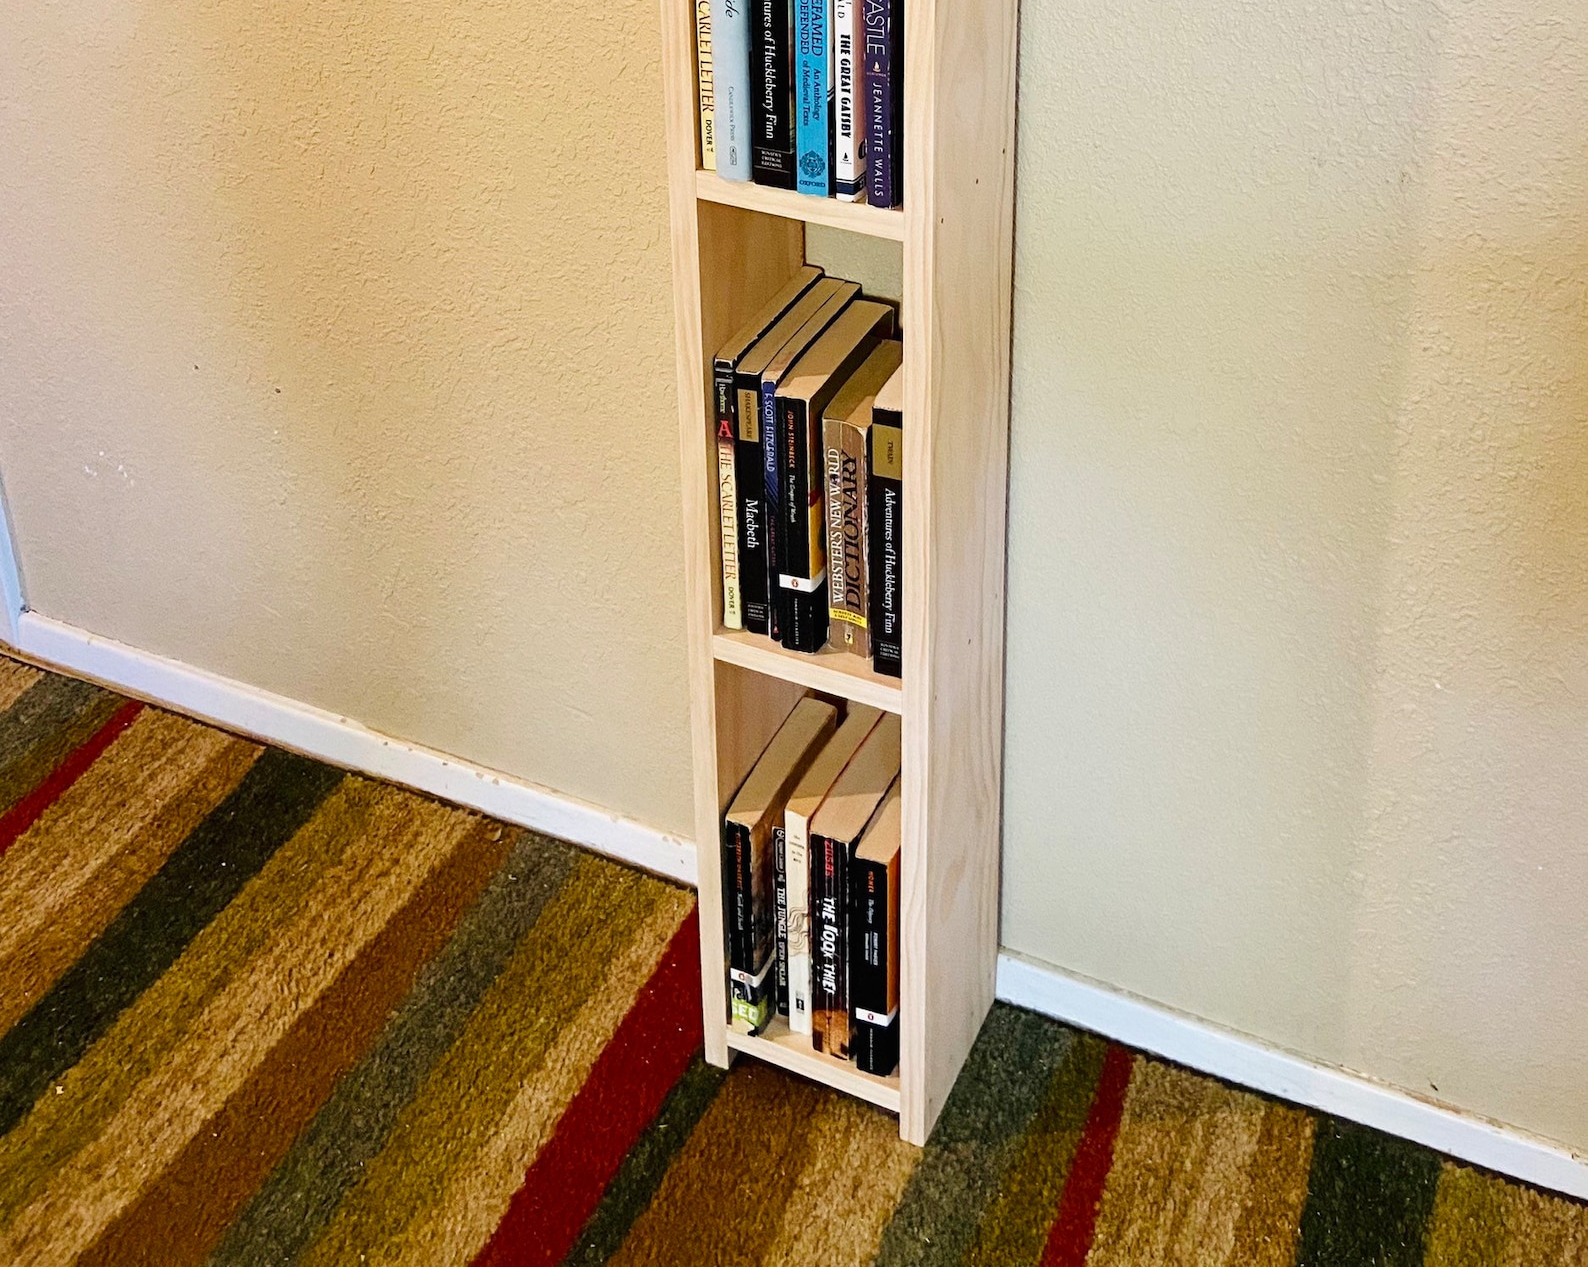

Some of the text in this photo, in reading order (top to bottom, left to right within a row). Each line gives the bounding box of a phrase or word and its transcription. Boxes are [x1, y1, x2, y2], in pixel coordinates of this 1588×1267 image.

[764, 29, 776, 45] of
[762, 45, 777, 112] Huckleberry
[802, 60, 810, 69] of
[700, 60, 714, 112] LETTER
[802, 69, 810, 105] Medieval
[812, 68, 822, 121] An Anthology
[840, 34, 852, 139] THE GREAT GATSBY
[765, 114, 777, 139] Finn
[873, 82, 883, 153] JEANNETTE
[799, 180, 826, 188] OXFORD
[874, 158, 884, 197] WALLS
[765, 399, 774, 423] SCOTT
[765, 425, 775, 472] FITZGERALD
[788, 432, 796, 469] STEINBECK
[720, 442, 736, 580] THE SCARLET LETTER
[746, 498, 760, 549] Macbeth
[829, 500, 842, 528] NEW
[841, 449, 861, 611] DICTIONARY
[885, 487, 896, 541] Adventures
[830, 530, 844, 604] WEBSTER'S
[885, 542, 896, 554] of
[882, 554, 896, 611] Huckleberry
[885, 612, 896, 634] Finn
[777, 887, 786, 905] THE
[822, 897, 837, 923] THE
[777, 906, 787, 939] JUNGLE
